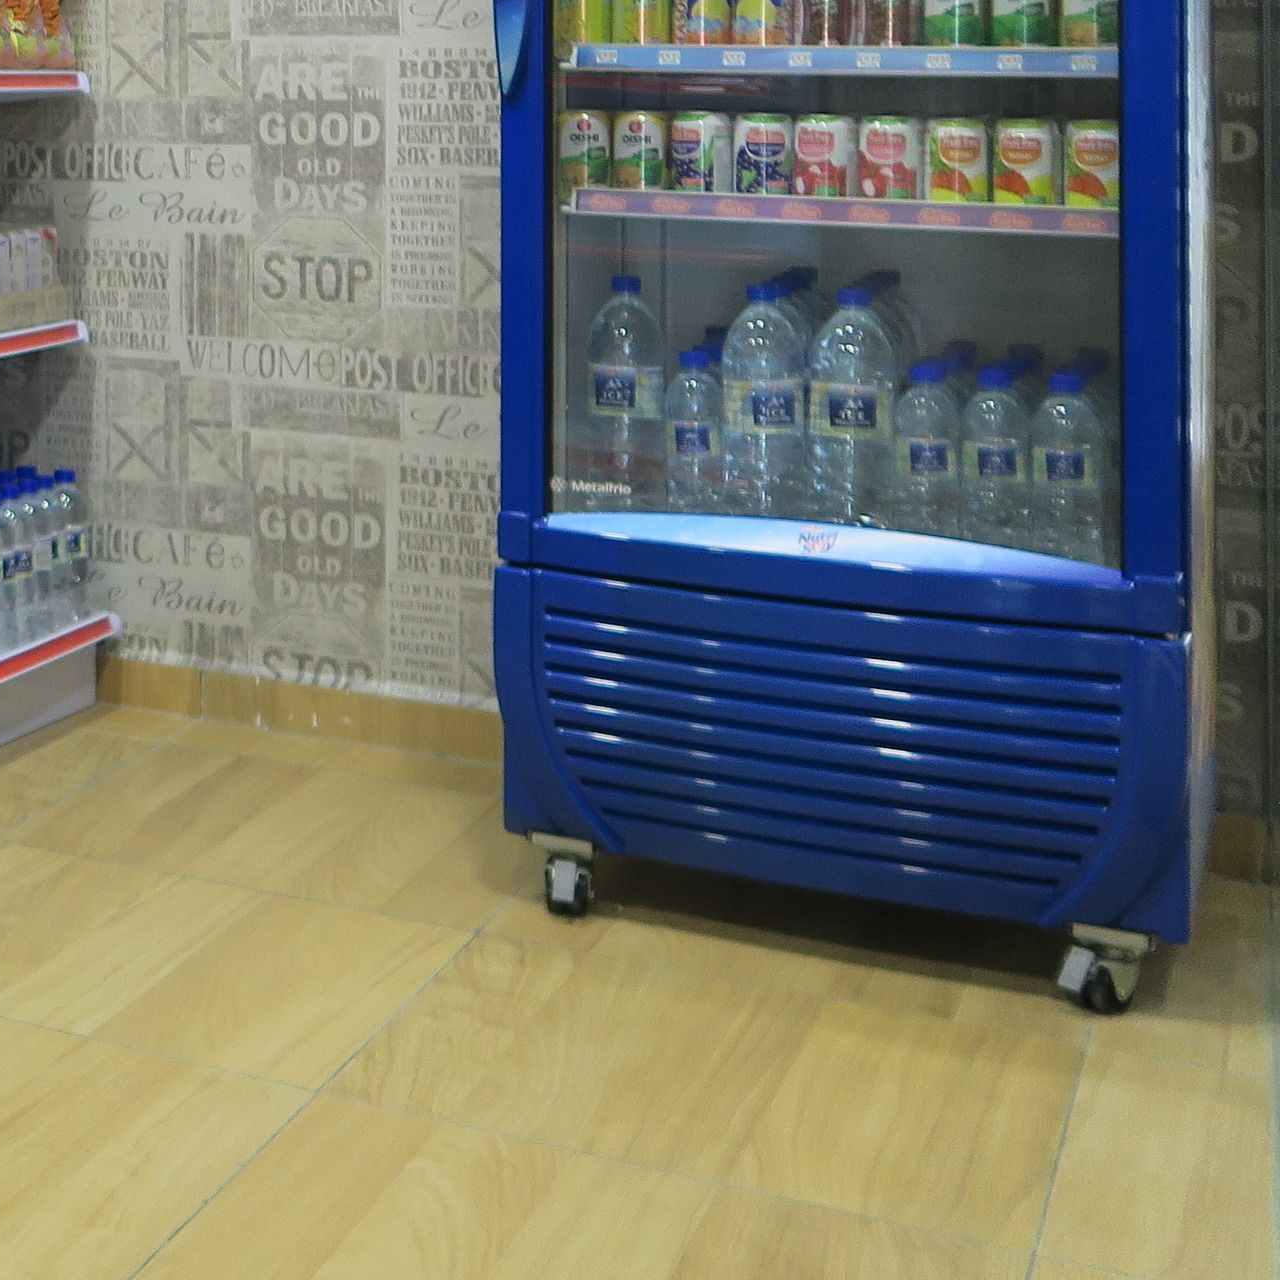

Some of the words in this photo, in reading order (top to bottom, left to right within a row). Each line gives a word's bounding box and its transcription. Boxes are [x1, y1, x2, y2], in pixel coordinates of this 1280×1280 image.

[254, 62, 349, 100] ARE
[259, 112, 380, 148] GOOD
[298, 158, 340, 177] OLD
[139, 192, 245, 224] Bain
[274, 176, 368, 213] DAYS
[262, 256, 373, 304] STOP
[342, 347, 400, 390] POST
[572, 479, 632, 496] Metalfrio
[259, 506, 381, 550] GOOD
[298, 555, 340, 574] OLD
[139, 575, 244, 617] Bain
[274, 571, 368, 615] DAYS
